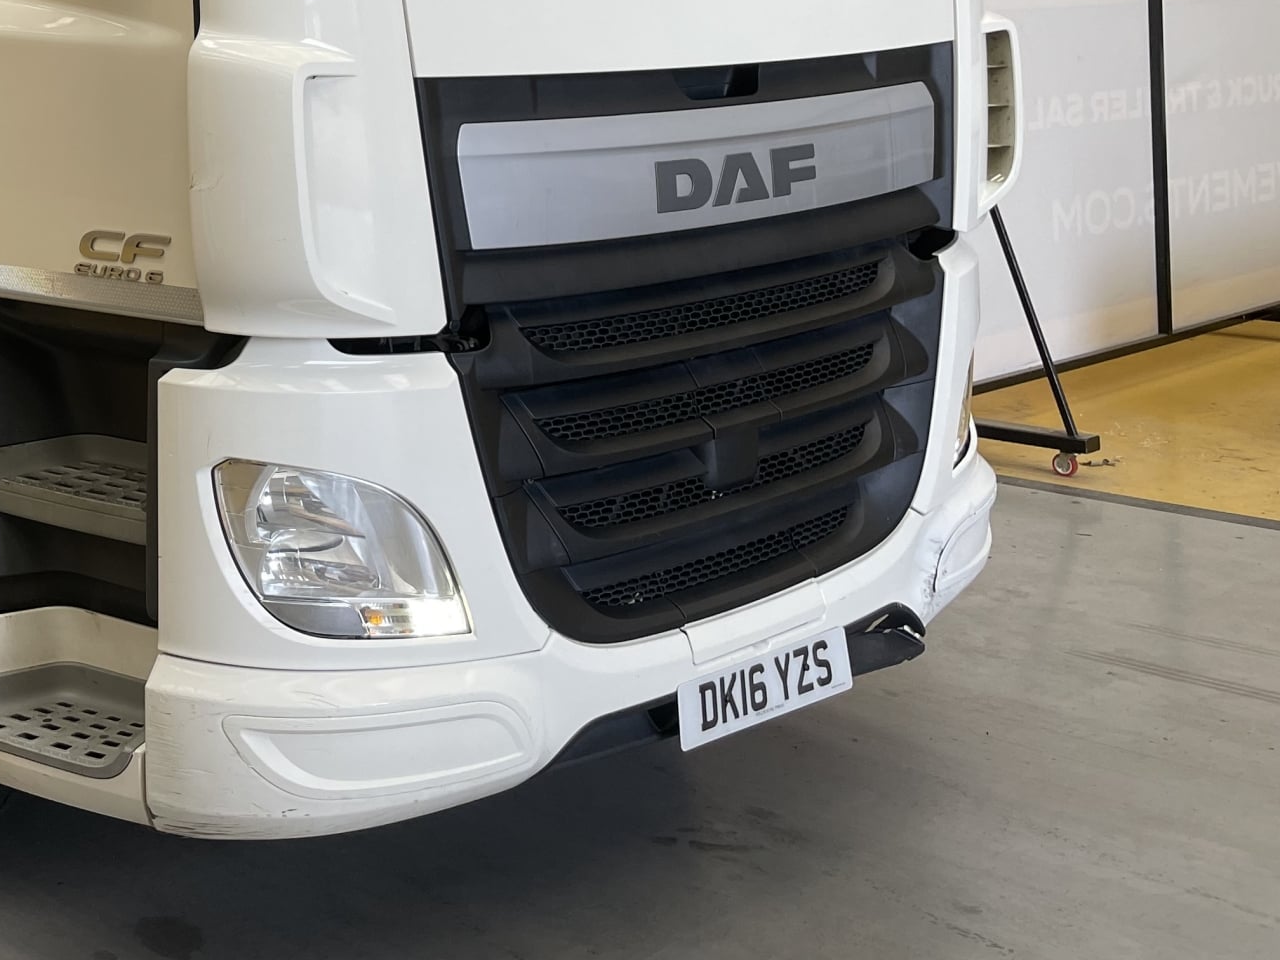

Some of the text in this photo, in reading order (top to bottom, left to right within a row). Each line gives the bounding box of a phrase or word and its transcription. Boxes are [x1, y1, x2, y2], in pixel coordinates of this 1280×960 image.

[654, 143, 817, 214] DAF
[79, 230, 172, 264] CF
[74, 262, 164, 285] EURO 6
[698, 639, 833, 732] DK16 YZS
